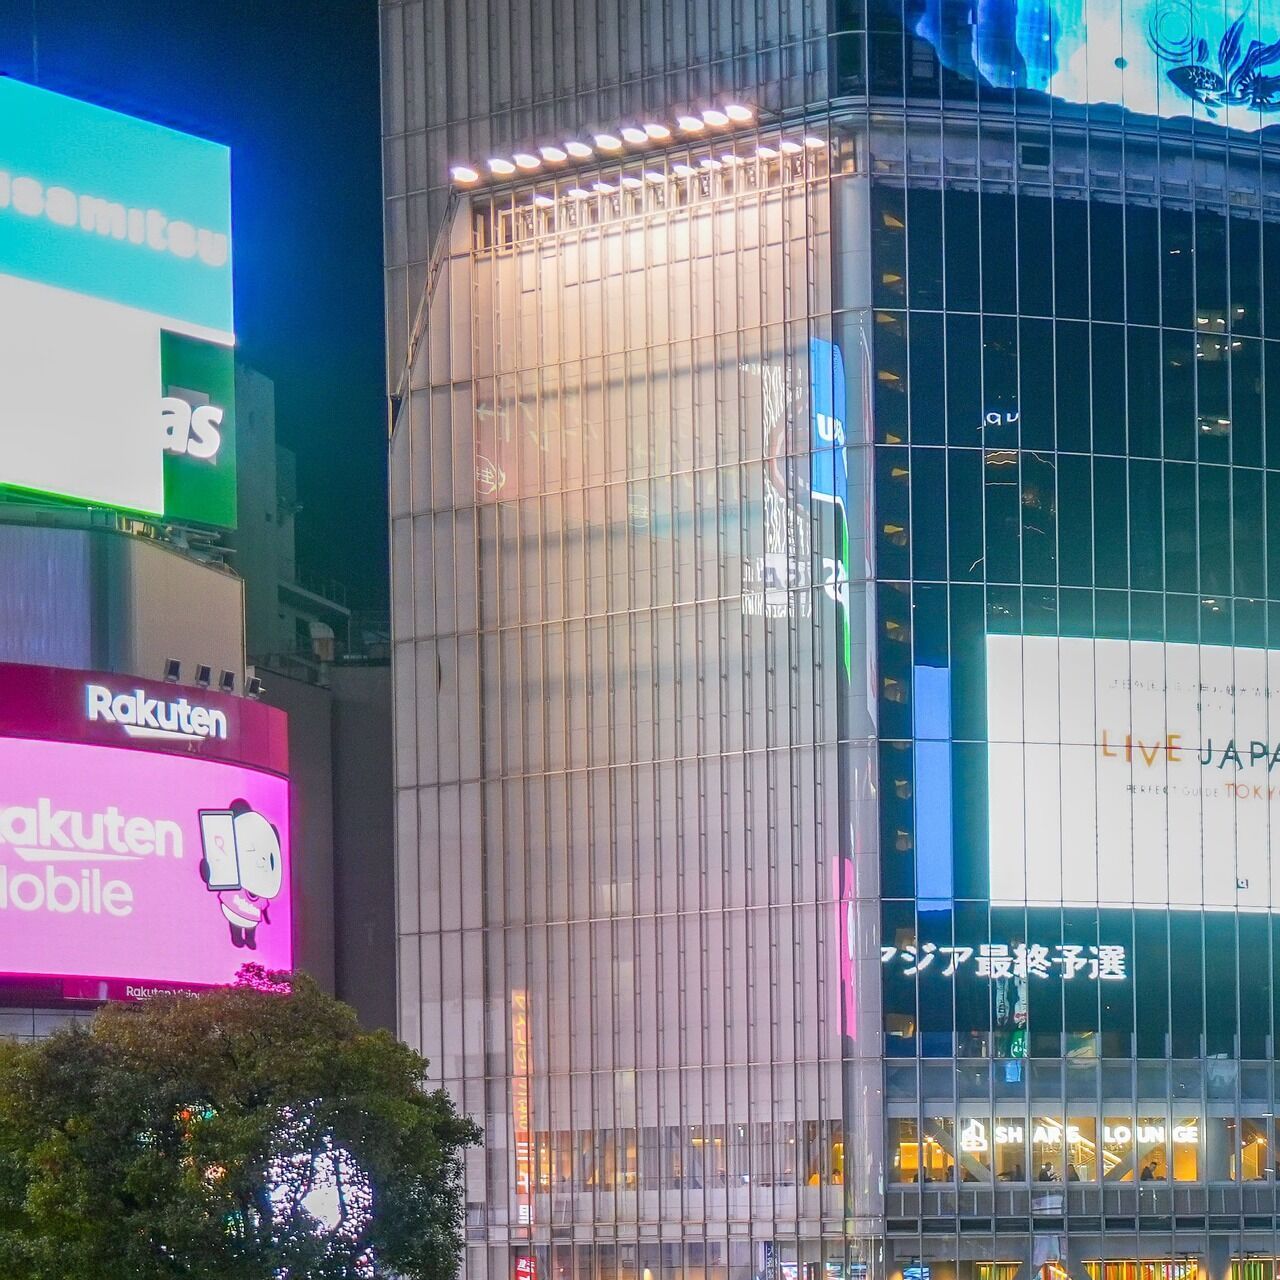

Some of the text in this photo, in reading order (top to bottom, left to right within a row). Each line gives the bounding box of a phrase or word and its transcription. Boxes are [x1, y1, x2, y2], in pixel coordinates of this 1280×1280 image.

[87, 685, 227, 740] Rakuten
[1102, 729, 1182, 768] LIVE
[0, 797, 183, 861] akuten
[0, 863, 134, 918] obile
[1104, 1126, 1198, 1143] LOUNGE
